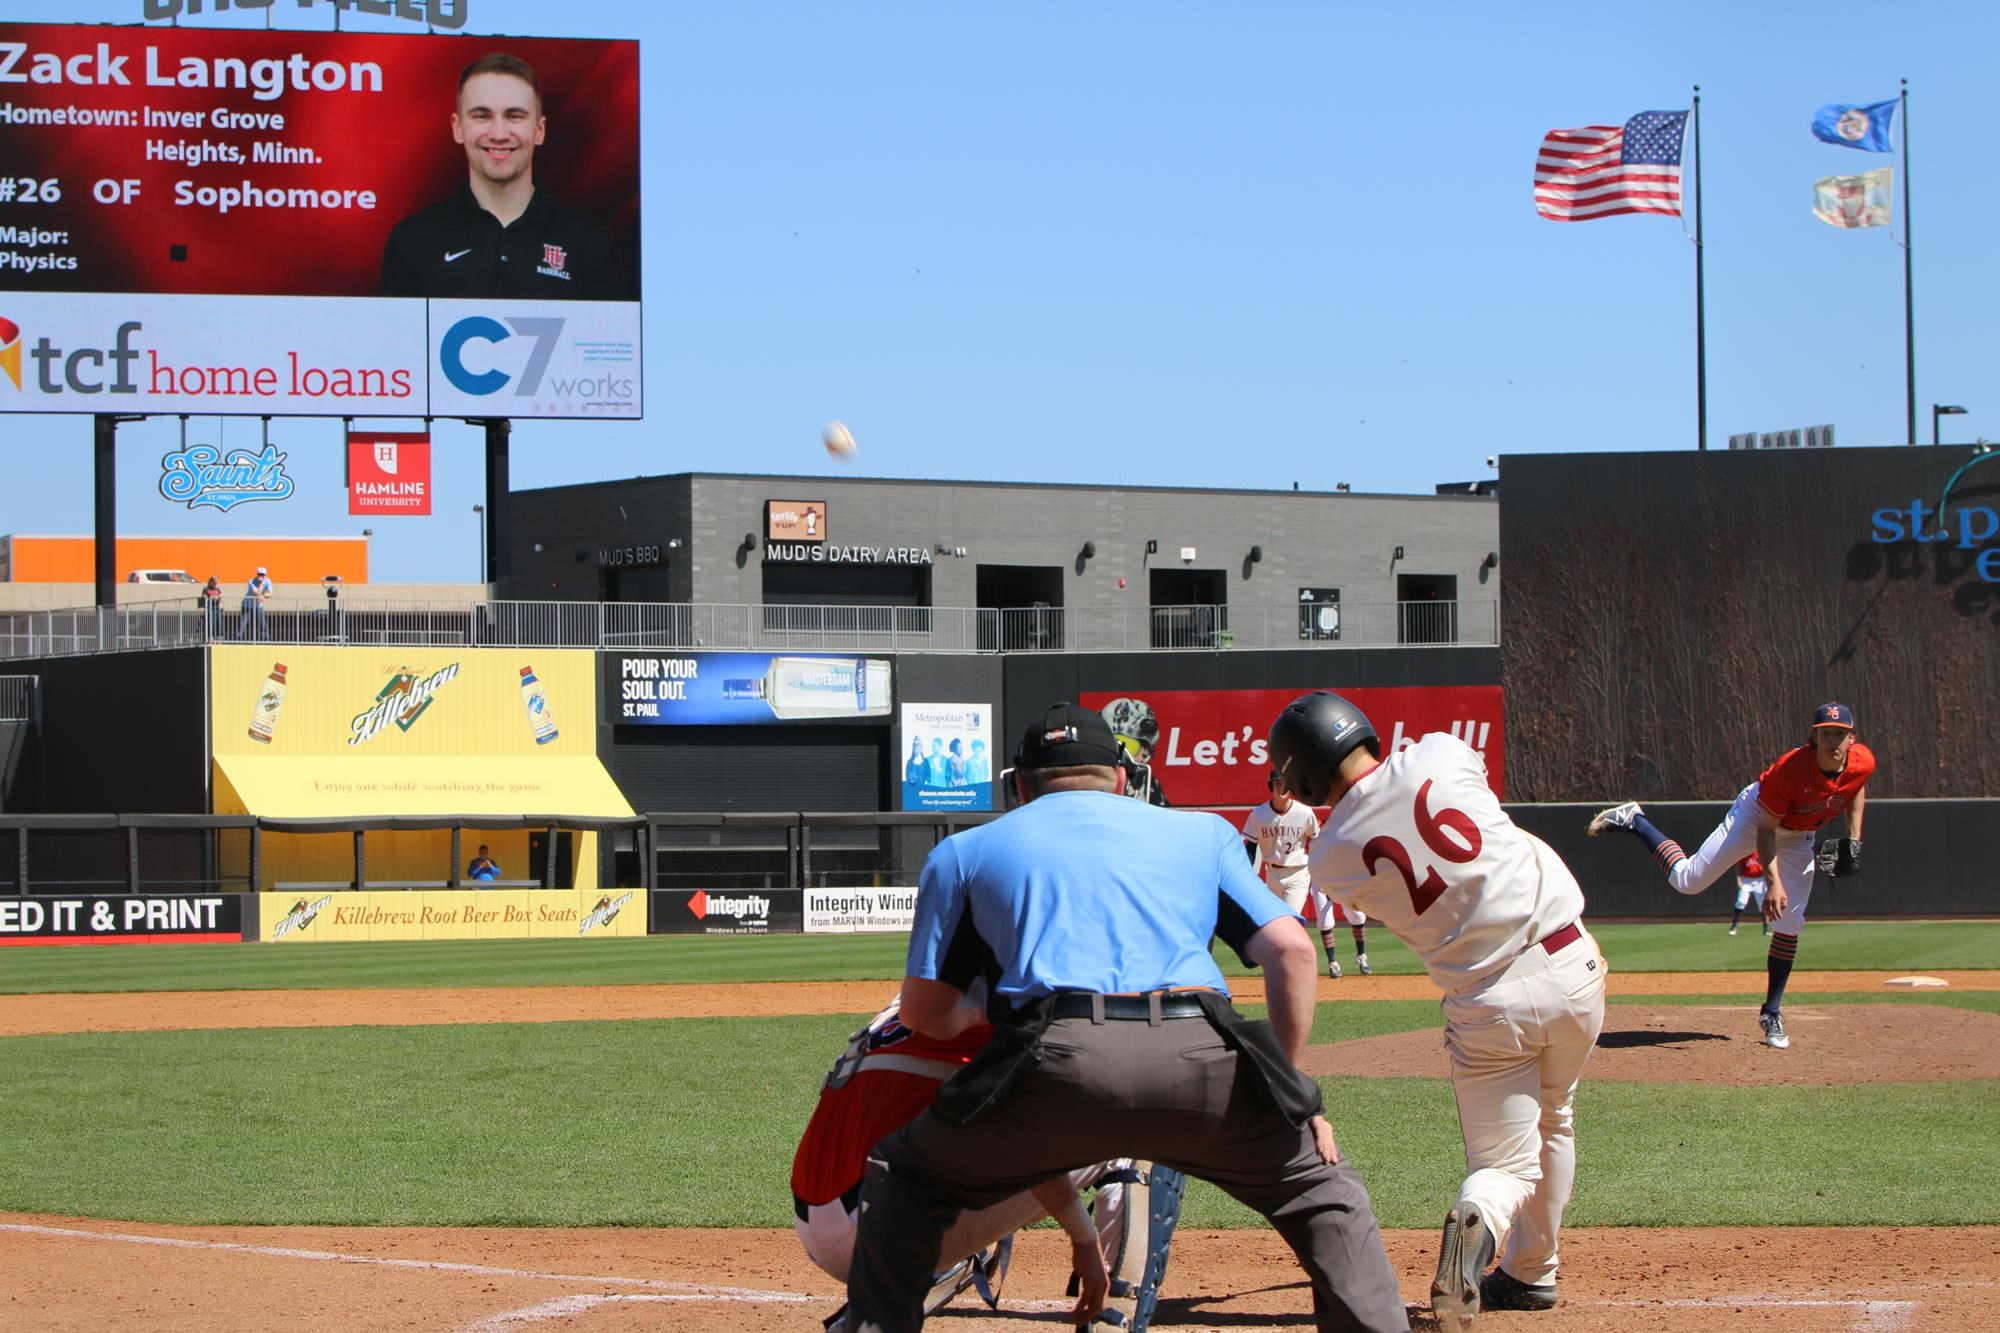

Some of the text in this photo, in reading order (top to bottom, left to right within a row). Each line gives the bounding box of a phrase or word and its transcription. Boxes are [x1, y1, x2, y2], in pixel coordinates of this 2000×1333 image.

[0, 42, 383, 100] Zack Langton
[0, 102, 284, 130] Hometown: Inver Grove
[146, 140, 322, 166] Heights, Minn.
[0, 177, 377, 213] #26 OF Sophomore
[0, 226, 68, 248] Major:
[0, 251, 78, 273] Physics
[536, 265, 572, 281] BASEBALL
[31, 321, 412, 398] tcf home loans
[440, 316, 566, 396] C7
[550, 372, 633, 398] works
[378, 447, 393, 461] H
[160, 444, 290, 502] Saints
[355, 482, 425, 495] HAMLINE
[358, 498, 422, 507] UNIVERSITY
[599, 545, 660, 565] MUD'S BBQ
[767, 544, 932, 564] MUD'S DAIRY AREA
[622, 658, 698, 679] POUR YOUR
[622, 680, 687, 700] SOUL OUT.
[347, 662, 460, 746] Killebrew
[623, 703, 660, 717] ST. PAUL
[914, 713, 964, 723] Metropolitan
[313, 781, 352, 793] Enjoy
[381, 782, 418, 791] while
[422, 782, 485, 793] watching
[486, 782, 505, 791] the
[508, 784, 542, 793] game
[1362, 777, 1482, 916] 26
[53, 901, 83, 931] IT
[91, 900, 116, 931] &
[124, 898, 223, 930] PRINT
[333, 904, 578, 925] Killebrew Root Beer Box Seats
[706, 895, 770, 918] Integrity
[810, 895, 873, 914] Integrity
[811, 917, 830, 926] from
[833, 916, 865, 926] MARVIN
[867, 916, 901, 925] Windows
